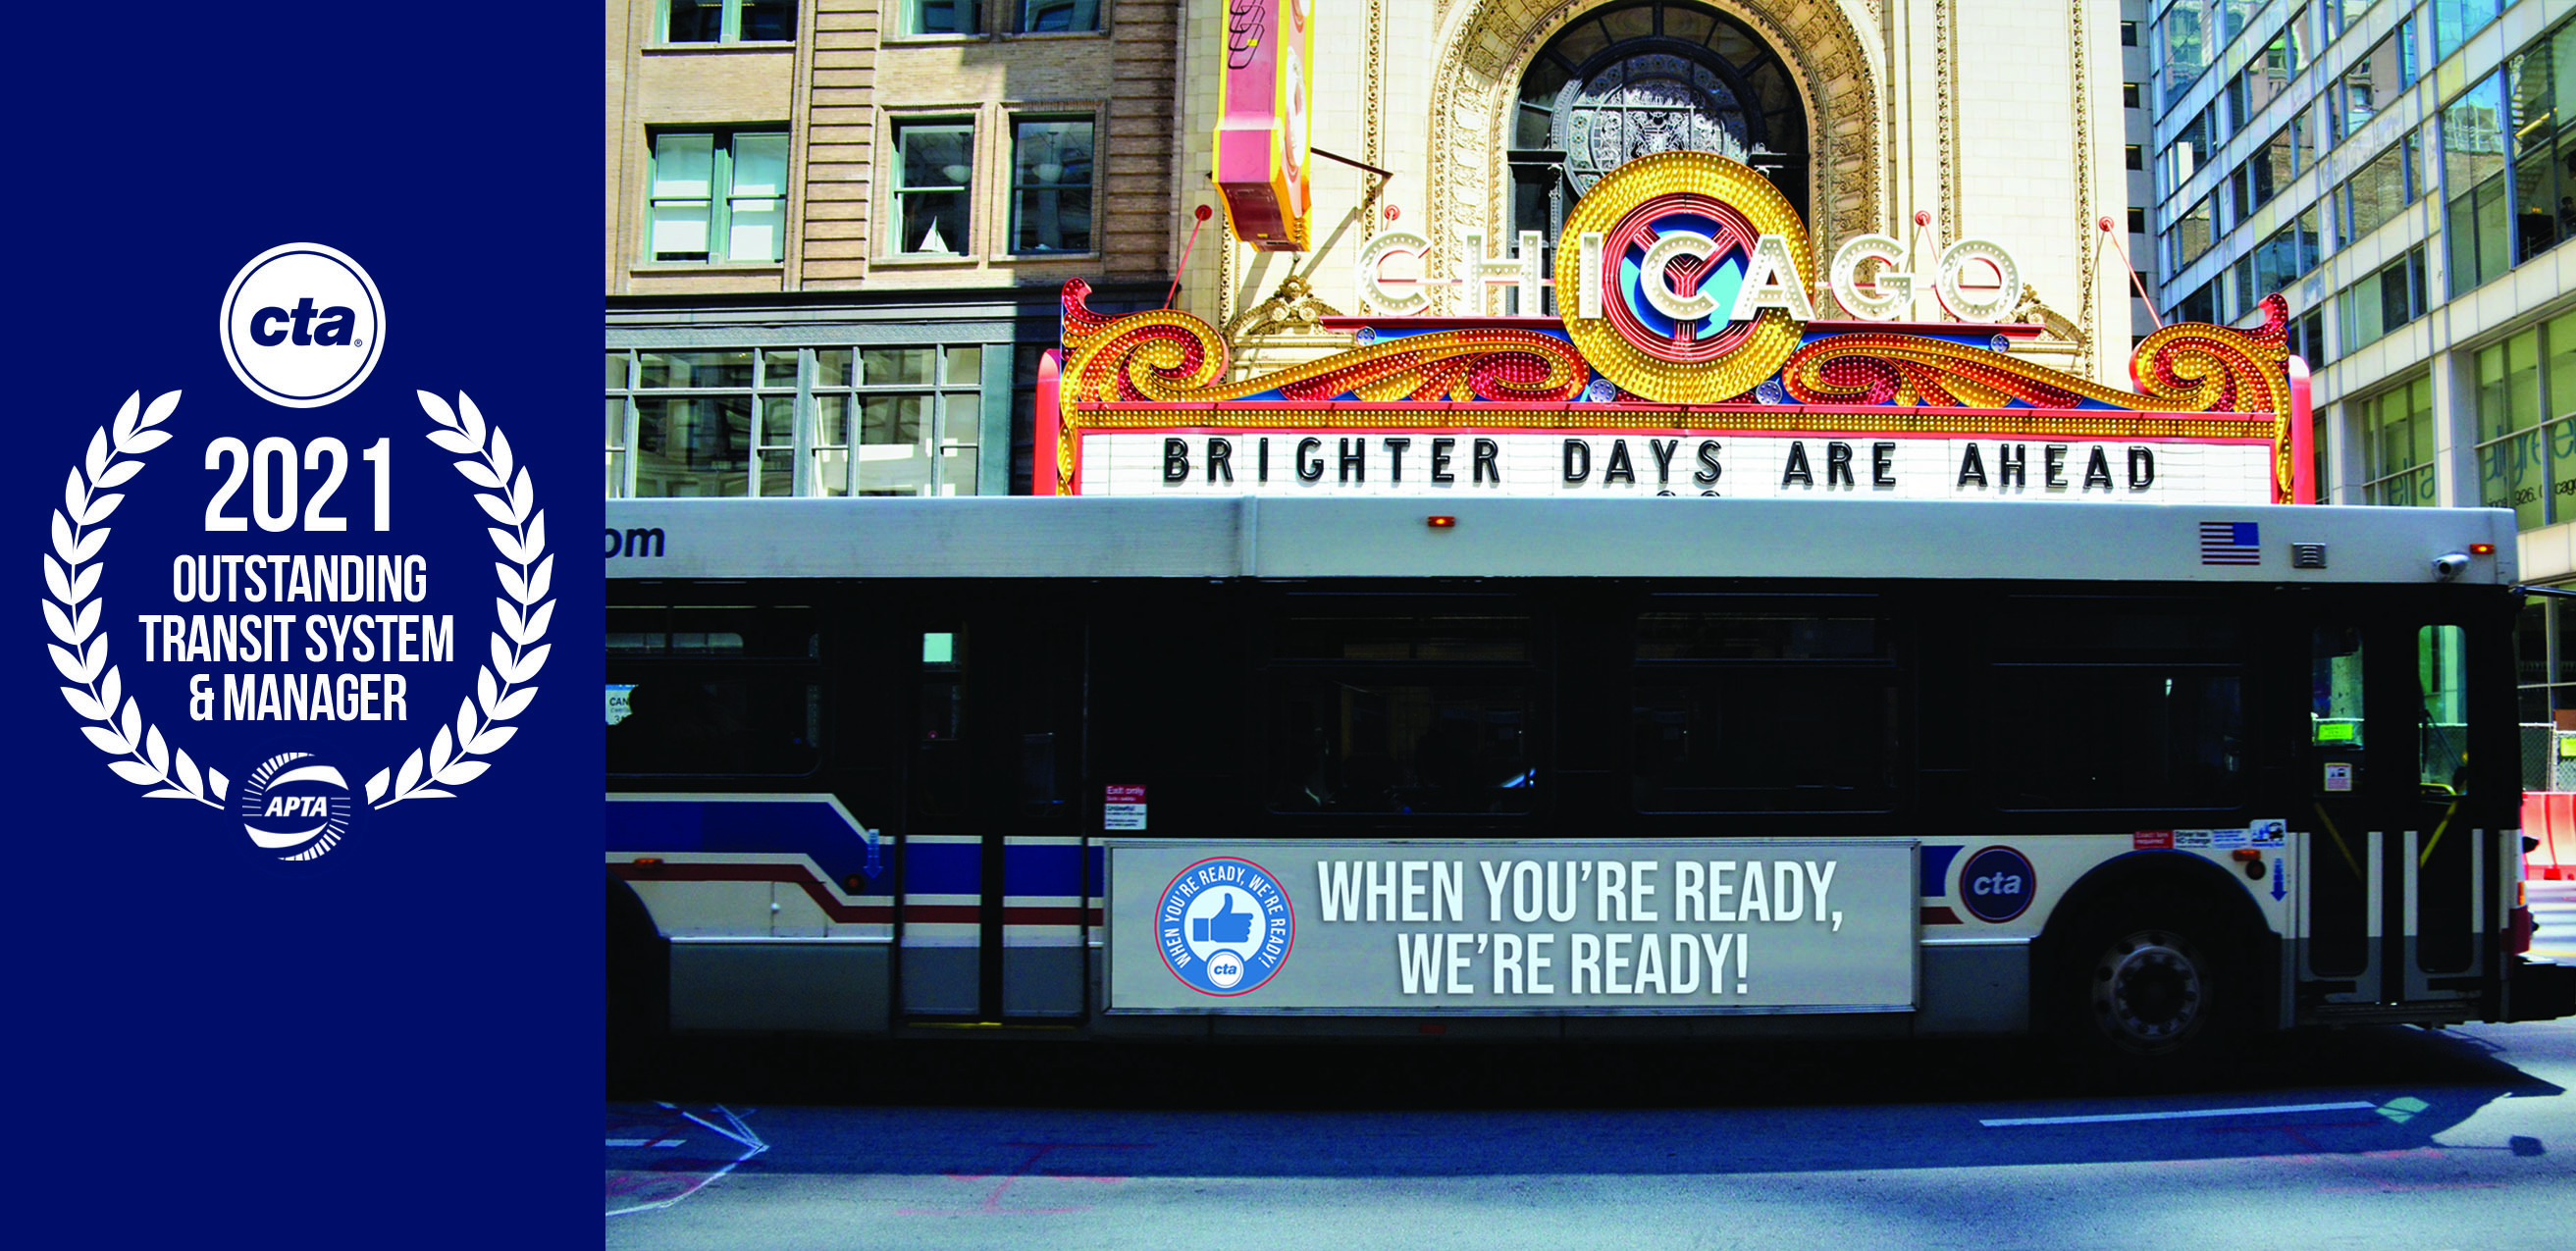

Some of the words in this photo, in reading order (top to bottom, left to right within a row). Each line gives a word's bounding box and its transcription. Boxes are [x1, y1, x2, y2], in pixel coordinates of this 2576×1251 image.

[1357, 230, 2023, 322] CHICAGO
[1163, 437, 1501, 484] BRIGHTER
[1563, 438, 1722, 485] DAYS
[1782, 441, 1898, 488] ARE
[1957, 443, 2157, 491] AHEAD
[1317, 860, 1463, 921] WHEN
[1675, 860, 1844, 931] READY,
[1973, 872, 2022, 896] cta
[1164, 928, 1192, 968] WHEN
[1198, 865, 1245, 886] READY,
[1258, 918, 1286, 968] READY!
[1213, 964, 1237, 975] cta
[1571, 933, 1749, 994] READY!
